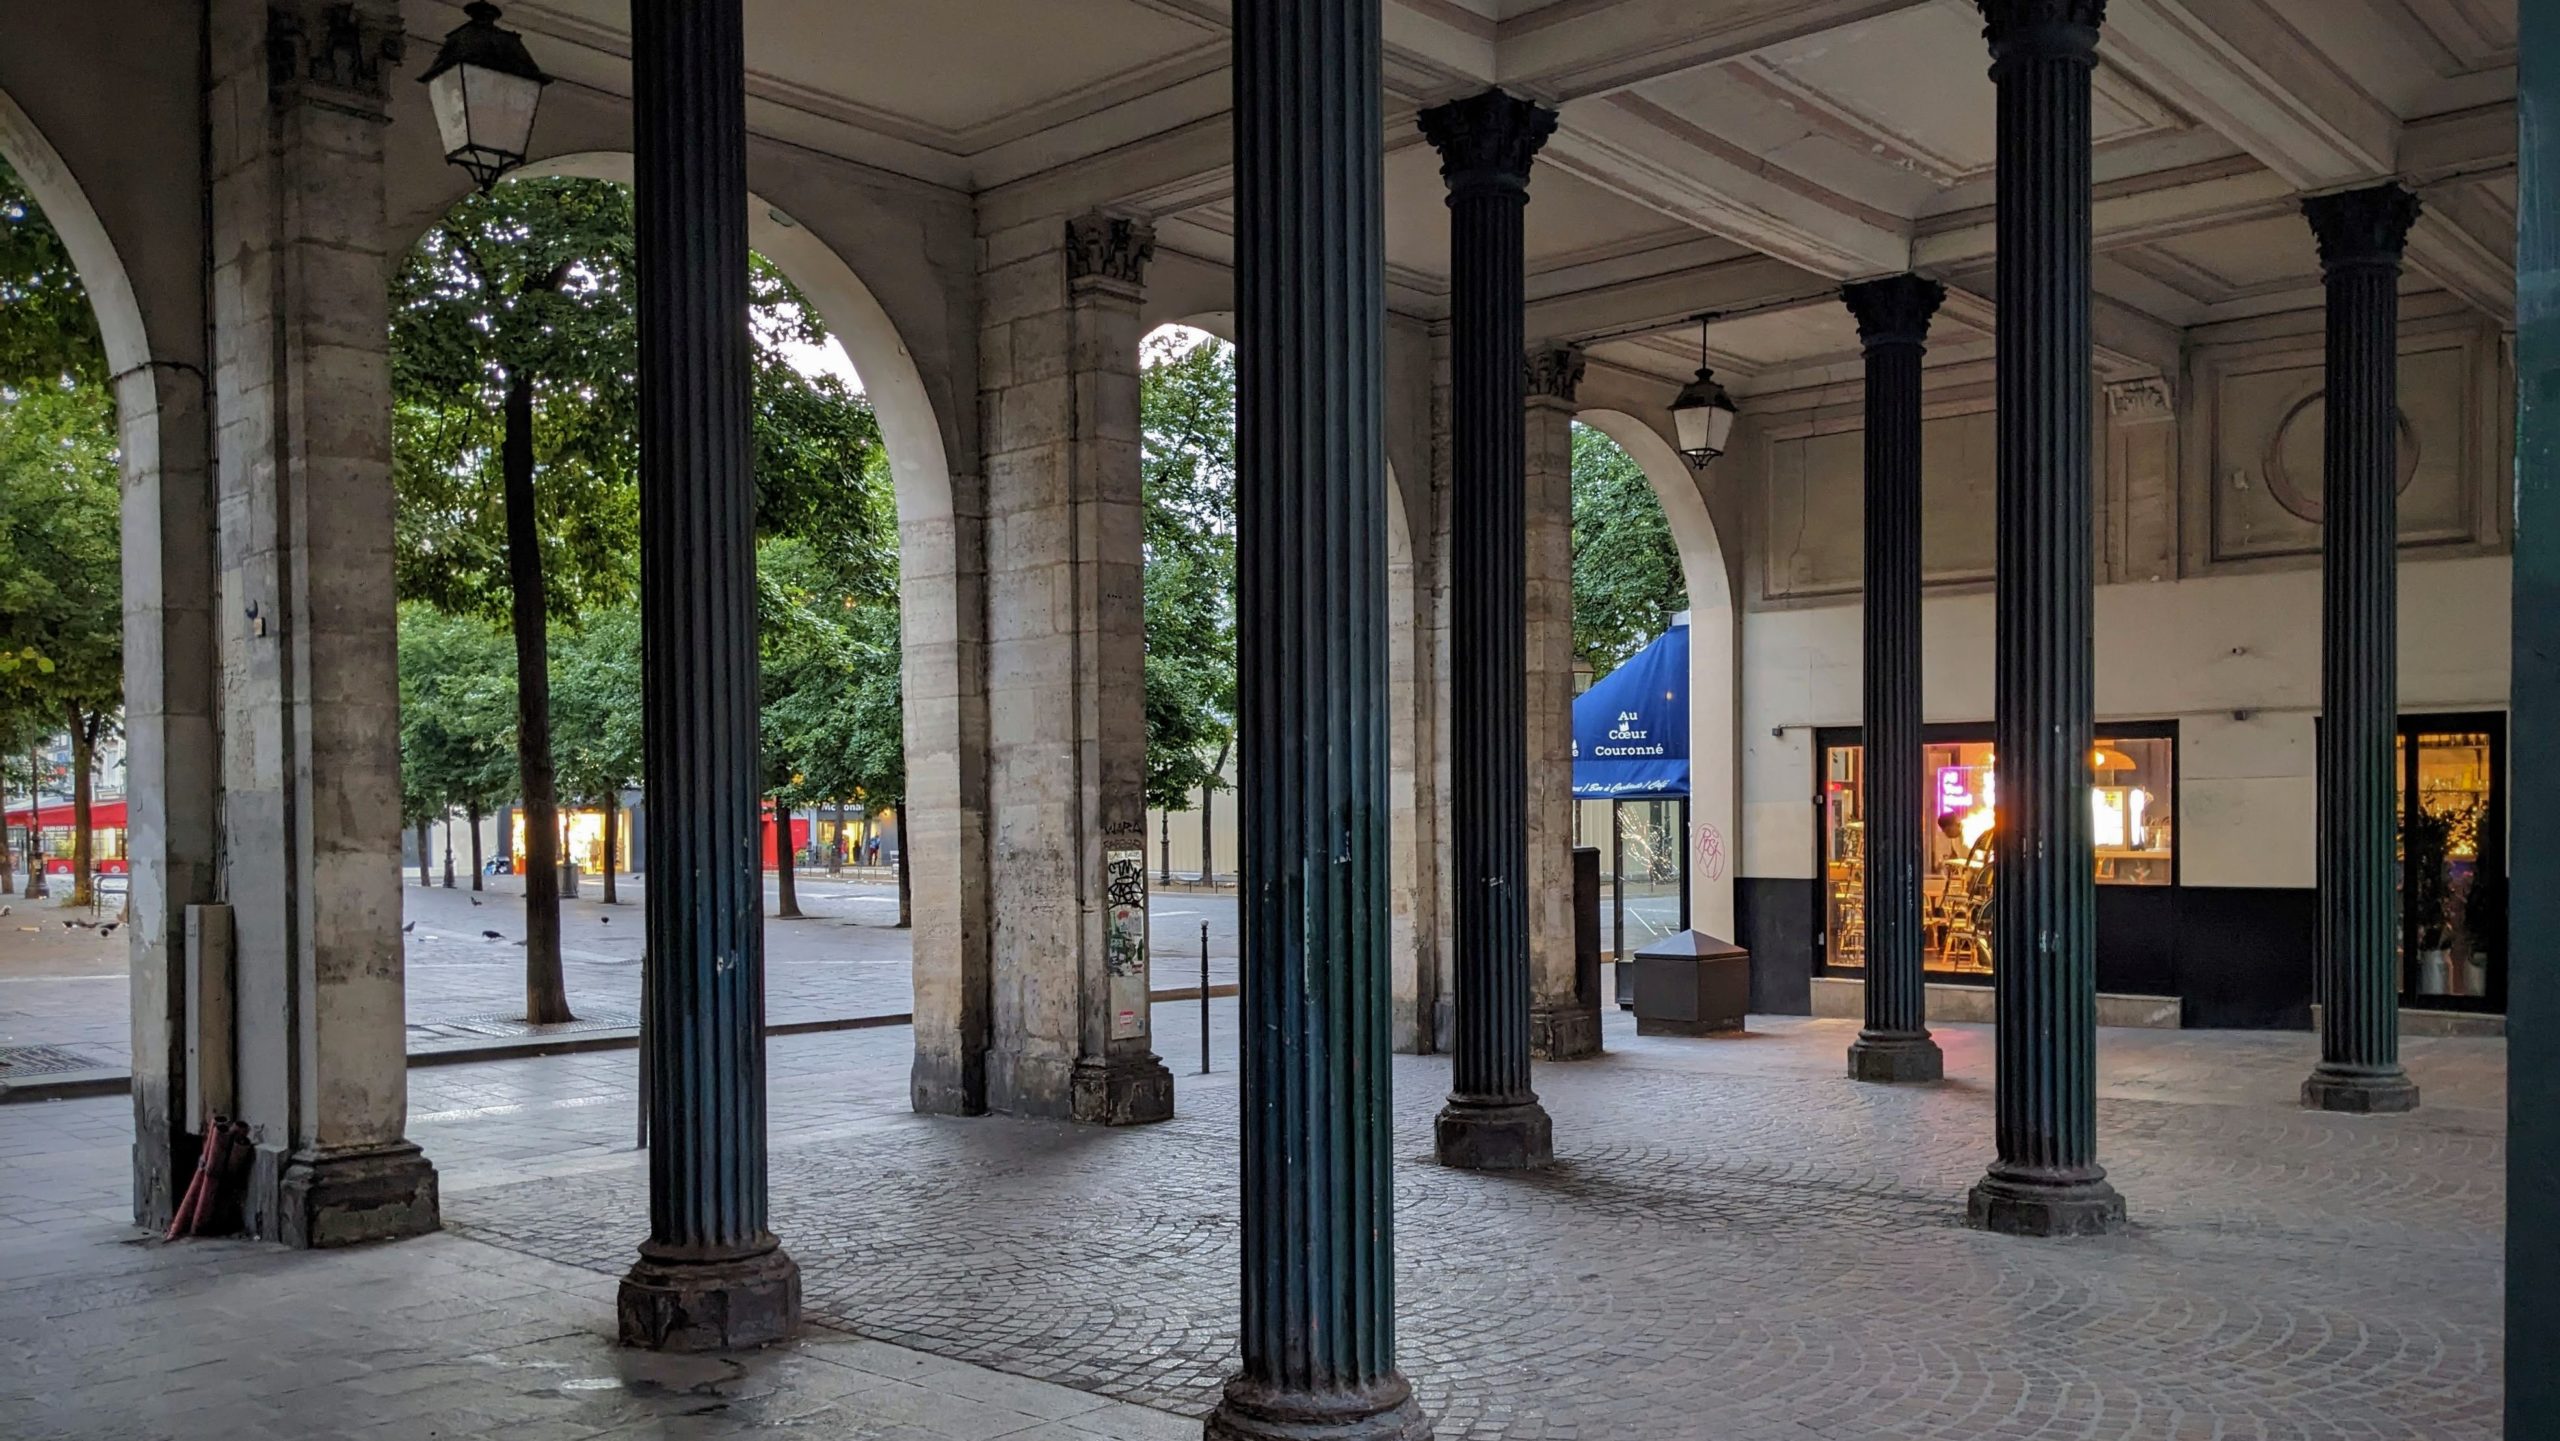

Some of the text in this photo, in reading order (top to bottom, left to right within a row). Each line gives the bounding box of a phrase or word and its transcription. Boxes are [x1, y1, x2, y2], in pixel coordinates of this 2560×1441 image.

[1618, 711, 1638, 721] Au
[1609, 730, 1647, 740] Cœur
[1595, 743, 1664, 756] Couronné
